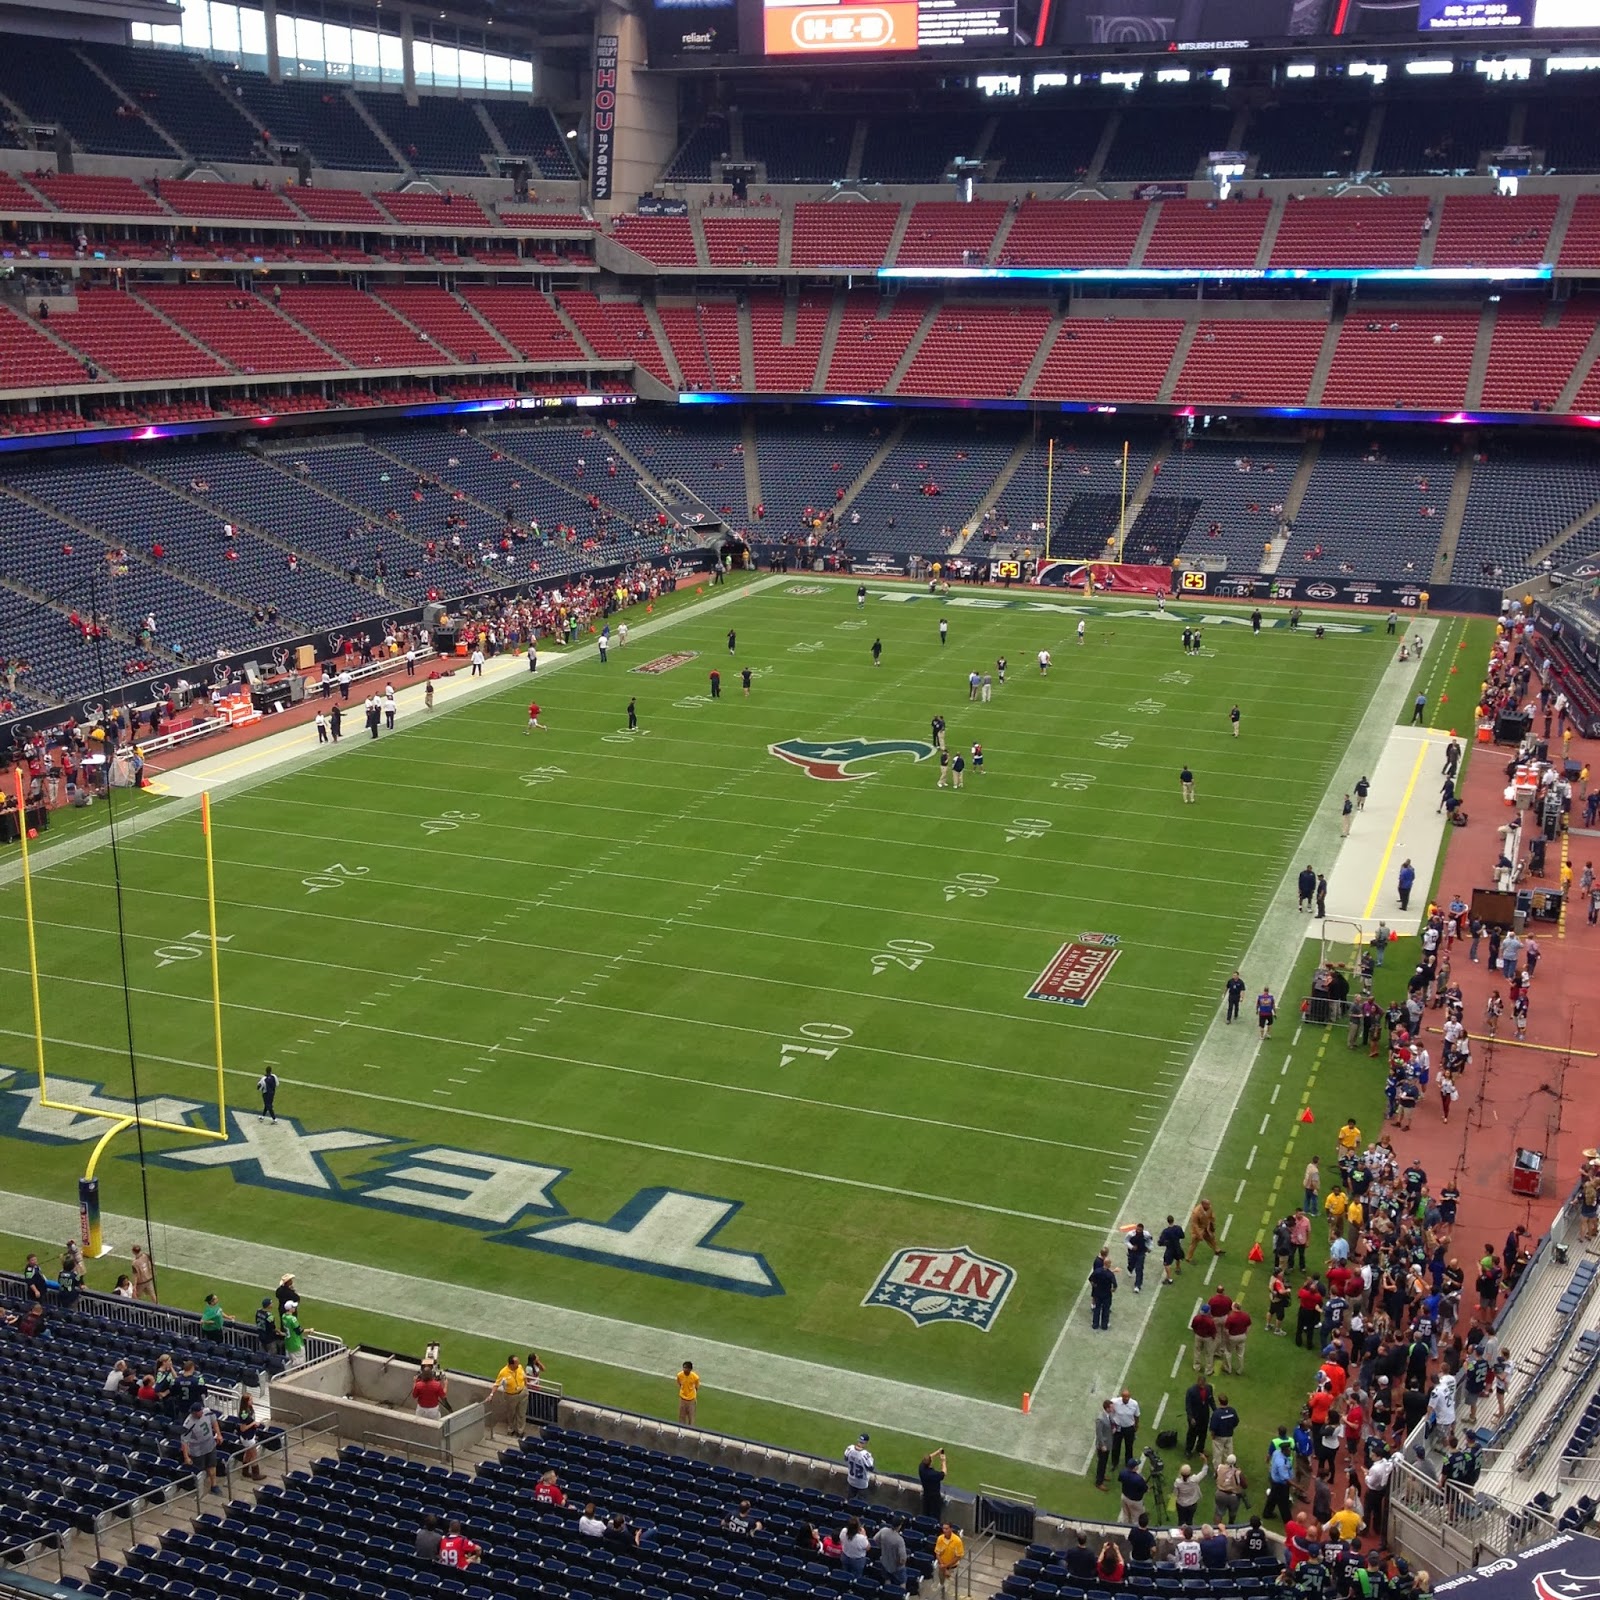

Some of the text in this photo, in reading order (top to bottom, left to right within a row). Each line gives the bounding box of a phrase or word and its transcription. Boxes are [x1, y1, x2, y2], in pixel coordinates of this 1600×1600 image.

[598, 37, 617, 47] NEED
[682, 32, 711, 43] reliant
[597, 47, 617, 56] HELP?
[1178, 40, 1249, 51] MITSUBISHI ELECTRIC
[599, 58, 616, 67] TEXT
[599, 134, 608, 143] TO
[1000, 562, 1017, 577] 25
[1185, 574, 1204, 588] 25
[1278, 588, 1292, 599] 94
[1354, 592, 1370, 604] 25
[1401, 595, 1417, 606] 46
[864, 588, 1374, 634] TEXANS
[1004, 817, 1053, 840] 40
[301, 863, 370, 889] 20
[943, 872, 1000, 898] 30
[154, 929, 235, 961] 10
[871, 938, 935, 972] 20
[1049, 949, 1081, 986] AMERICANO
[1038, 994, 1075, 1004] 2013
[780, 1021, 854, 1061] 10
[0, 1066, 786, 1297] TEXA
[904, 1253, 1003, 1299] NFL
[1418, 1325, 1432, 1336] 56
[181, 1386, 190, 1400] 3
[200, 1421, 210, 1437] 3
[849, 1461, 865, 1480] 12
[1249, 1538, 1262, 1550] 99
[441, 1549, 458, 1567] 99
[1184, 1552, 1198, 1566] 80
[1433, 1534, 1574, 1594] Appliances Conn's Furnitur
[1302, 1574, 1324, 1592] 24
